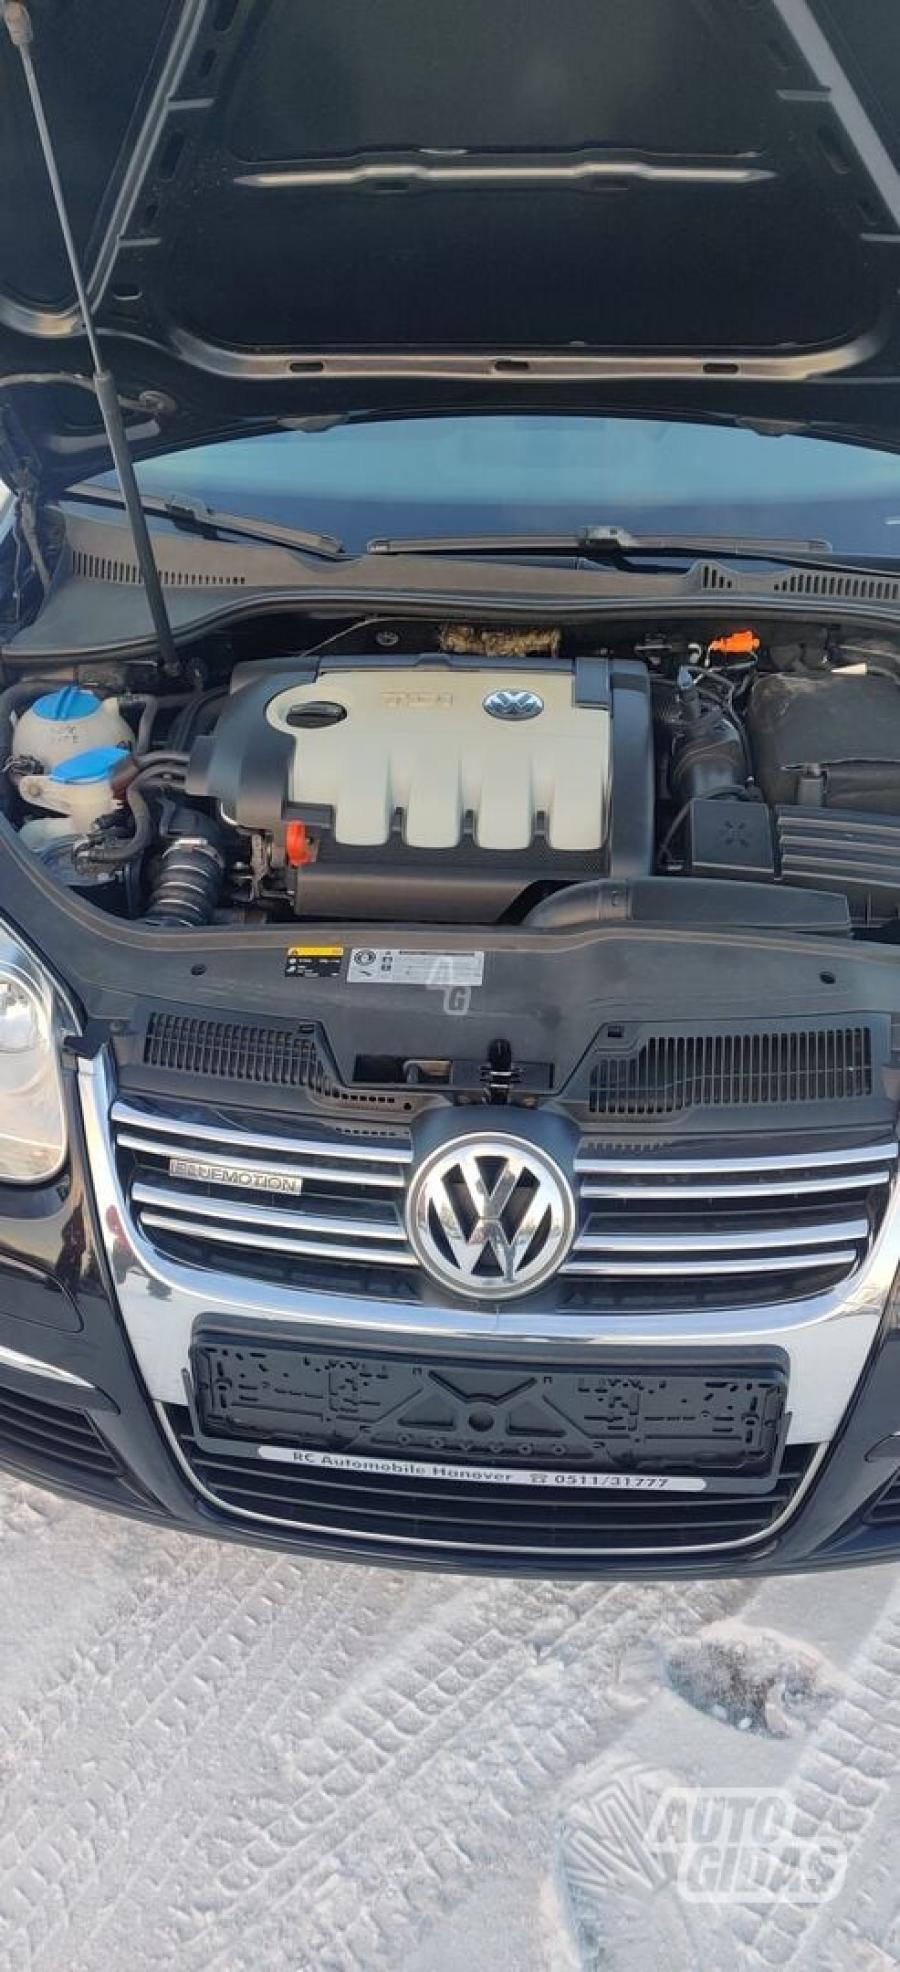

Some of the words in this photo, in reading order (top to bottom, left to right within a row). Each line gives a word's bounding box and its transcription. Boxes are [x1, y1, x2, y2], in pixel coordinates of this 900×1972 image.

[170, 1155, 297, 1192] BLUEMOTION
[412, 1136, 571, 1294] VW
[321, 1455, 426, 1474] Automobile
[432, 1466, 512, 1481] Hanover
[554, 1473, 669, 1488] 0511/31777
